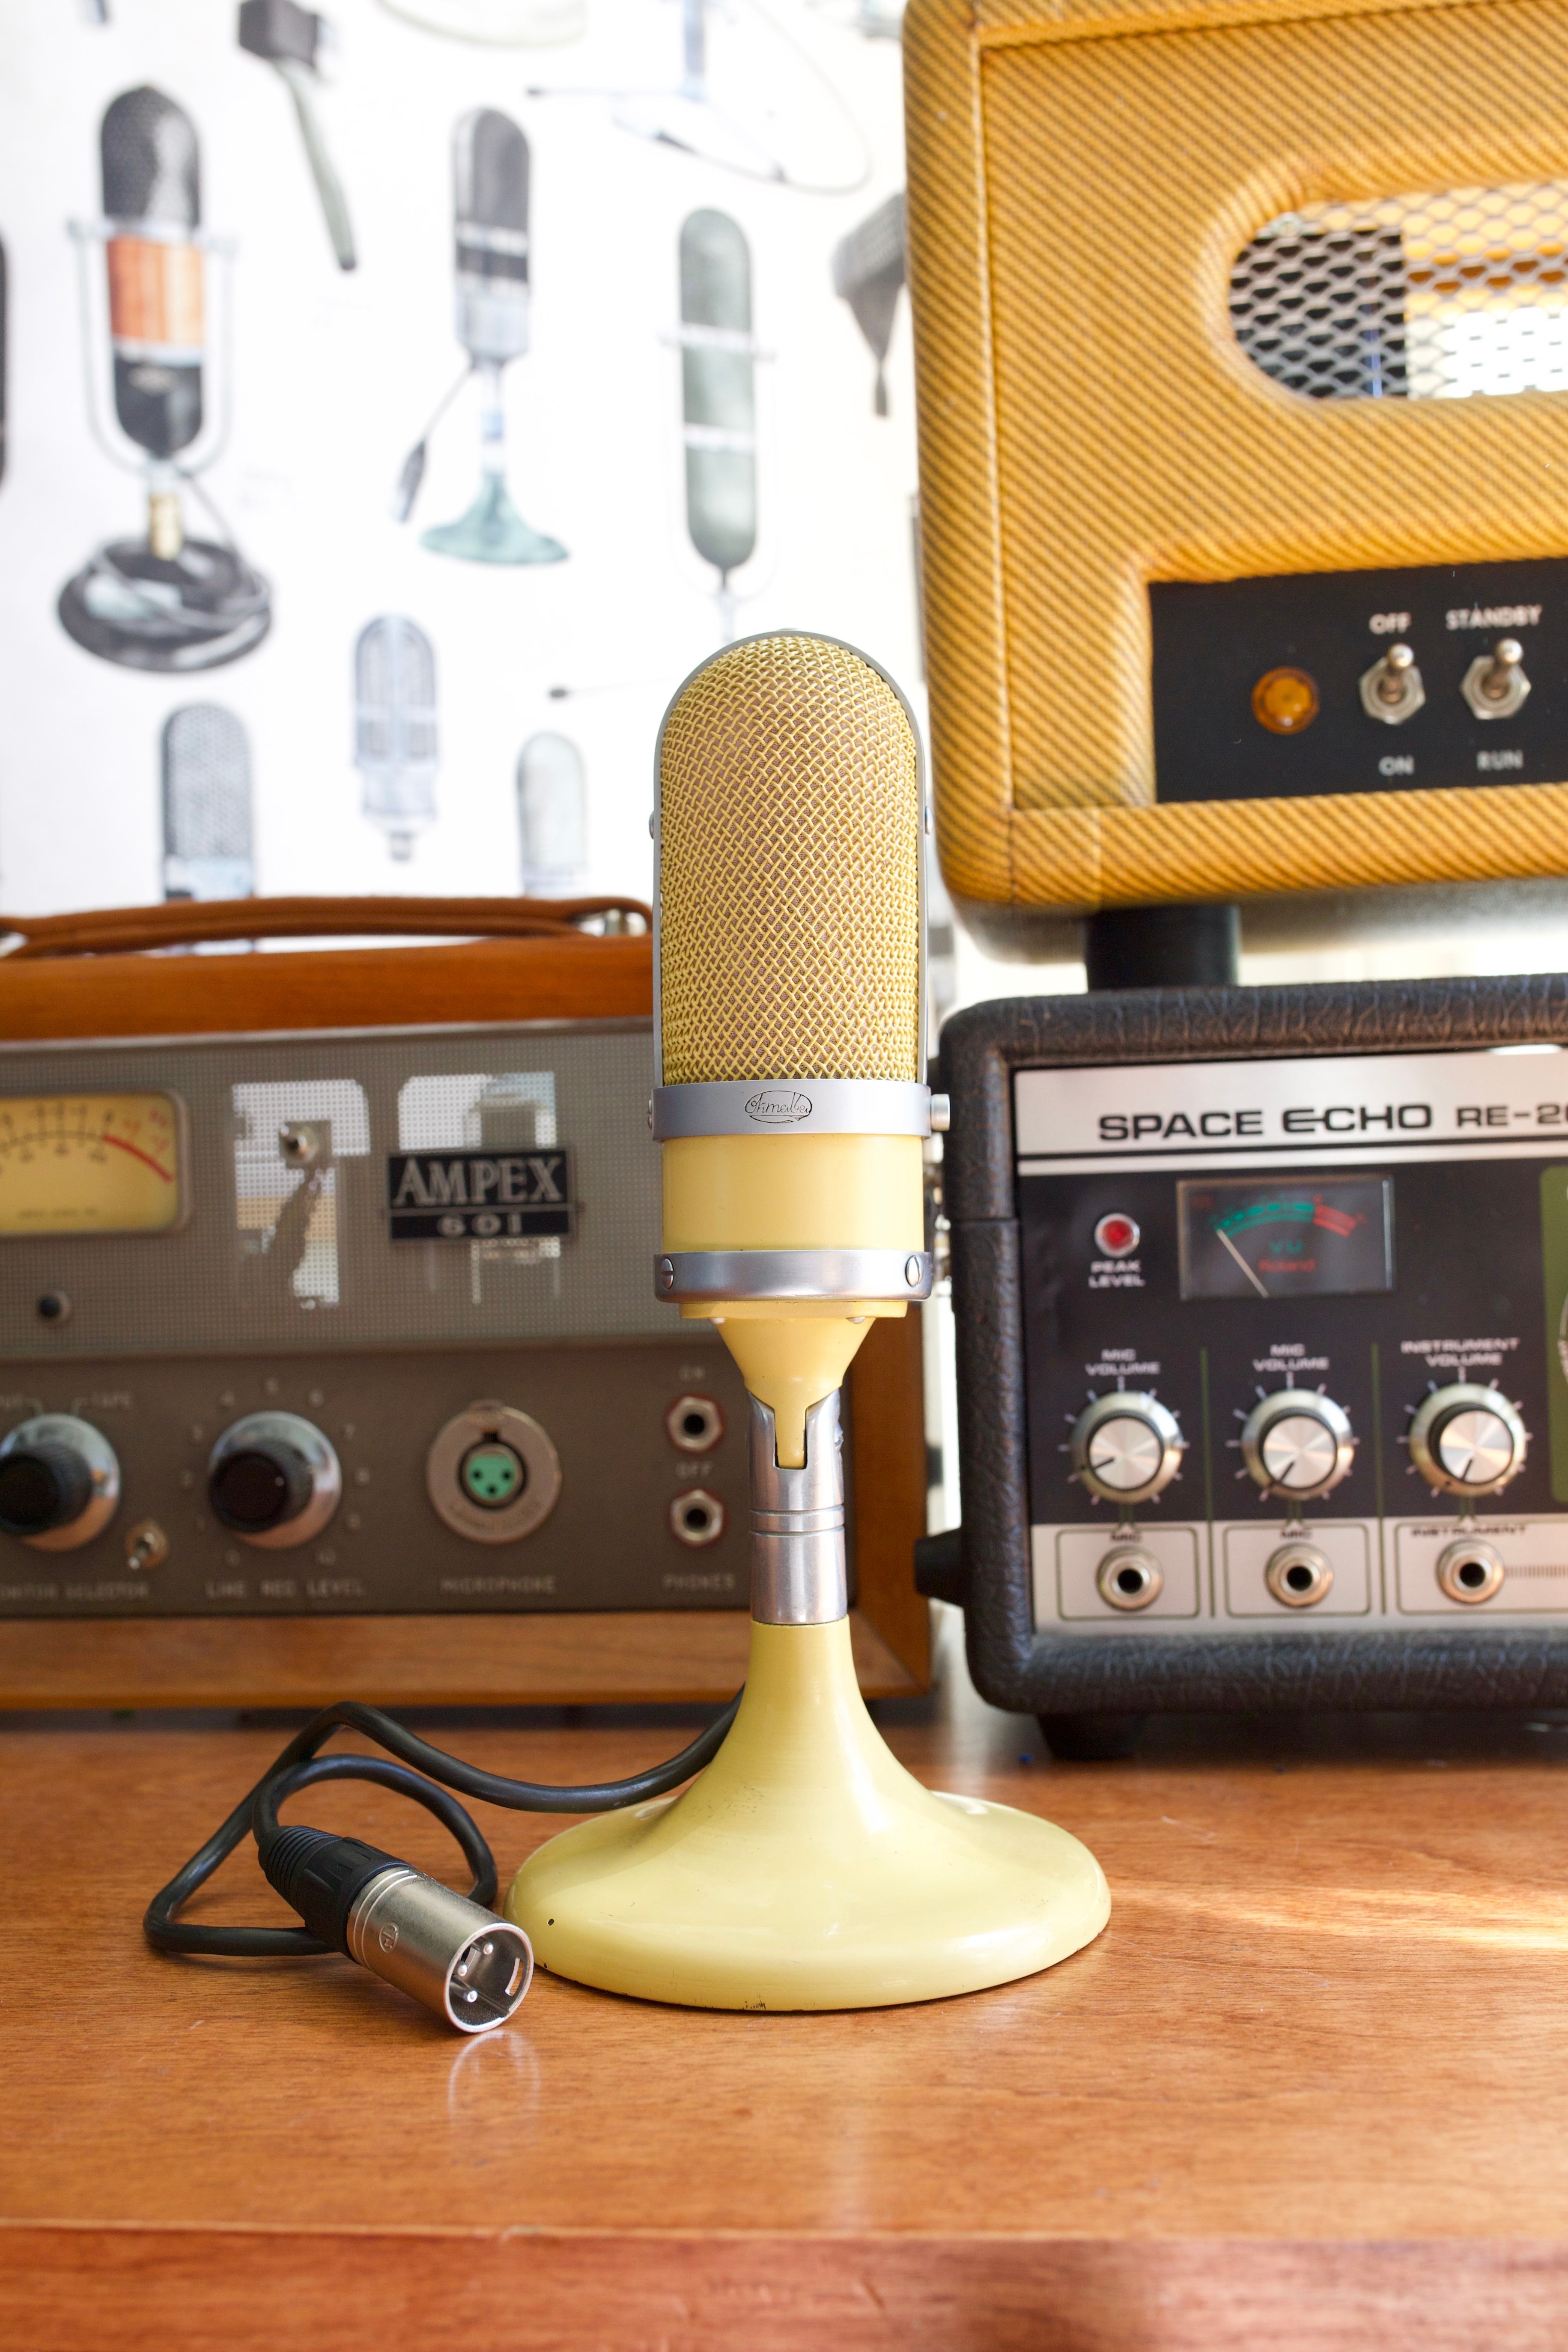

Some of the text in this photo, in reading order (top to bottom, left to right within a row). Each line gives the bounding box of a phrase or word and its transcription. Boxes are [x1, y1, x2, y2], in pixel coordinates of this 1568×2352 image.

[1370, 613, 1410, 634] OFF
[1446, 605, 1541, 630] STANDBY
[1379, 756, 1414, 776] ON
[1477, 750, 1523, 770] RUN
[1099, 1103, 1568, 1141] SPACE ECHO RE-2
[394, 1158, 563, 1206] AMPEX
[437, 1213, 523, 1237] 601
[1091, 1260, 1141, 1273] PEAK
[1088, 1274, 1145, 1288] LEVEL
[1270, 1344, 1305, 1357] MIC
[1401, 1337, 1519, 1354] INSTRUMENT
[1101, 1349, 1136, 1362] MIC
[1253, 1357, 1330, 1371] VOLUME
[1426, 1353, 1503, 1367] VOLUME
[1085, 1361, 1160, 1376] VOLUME
[440, 1574, 556, 1594] MICROPHONE
[663, 1572, 736, 1591] PHONES
